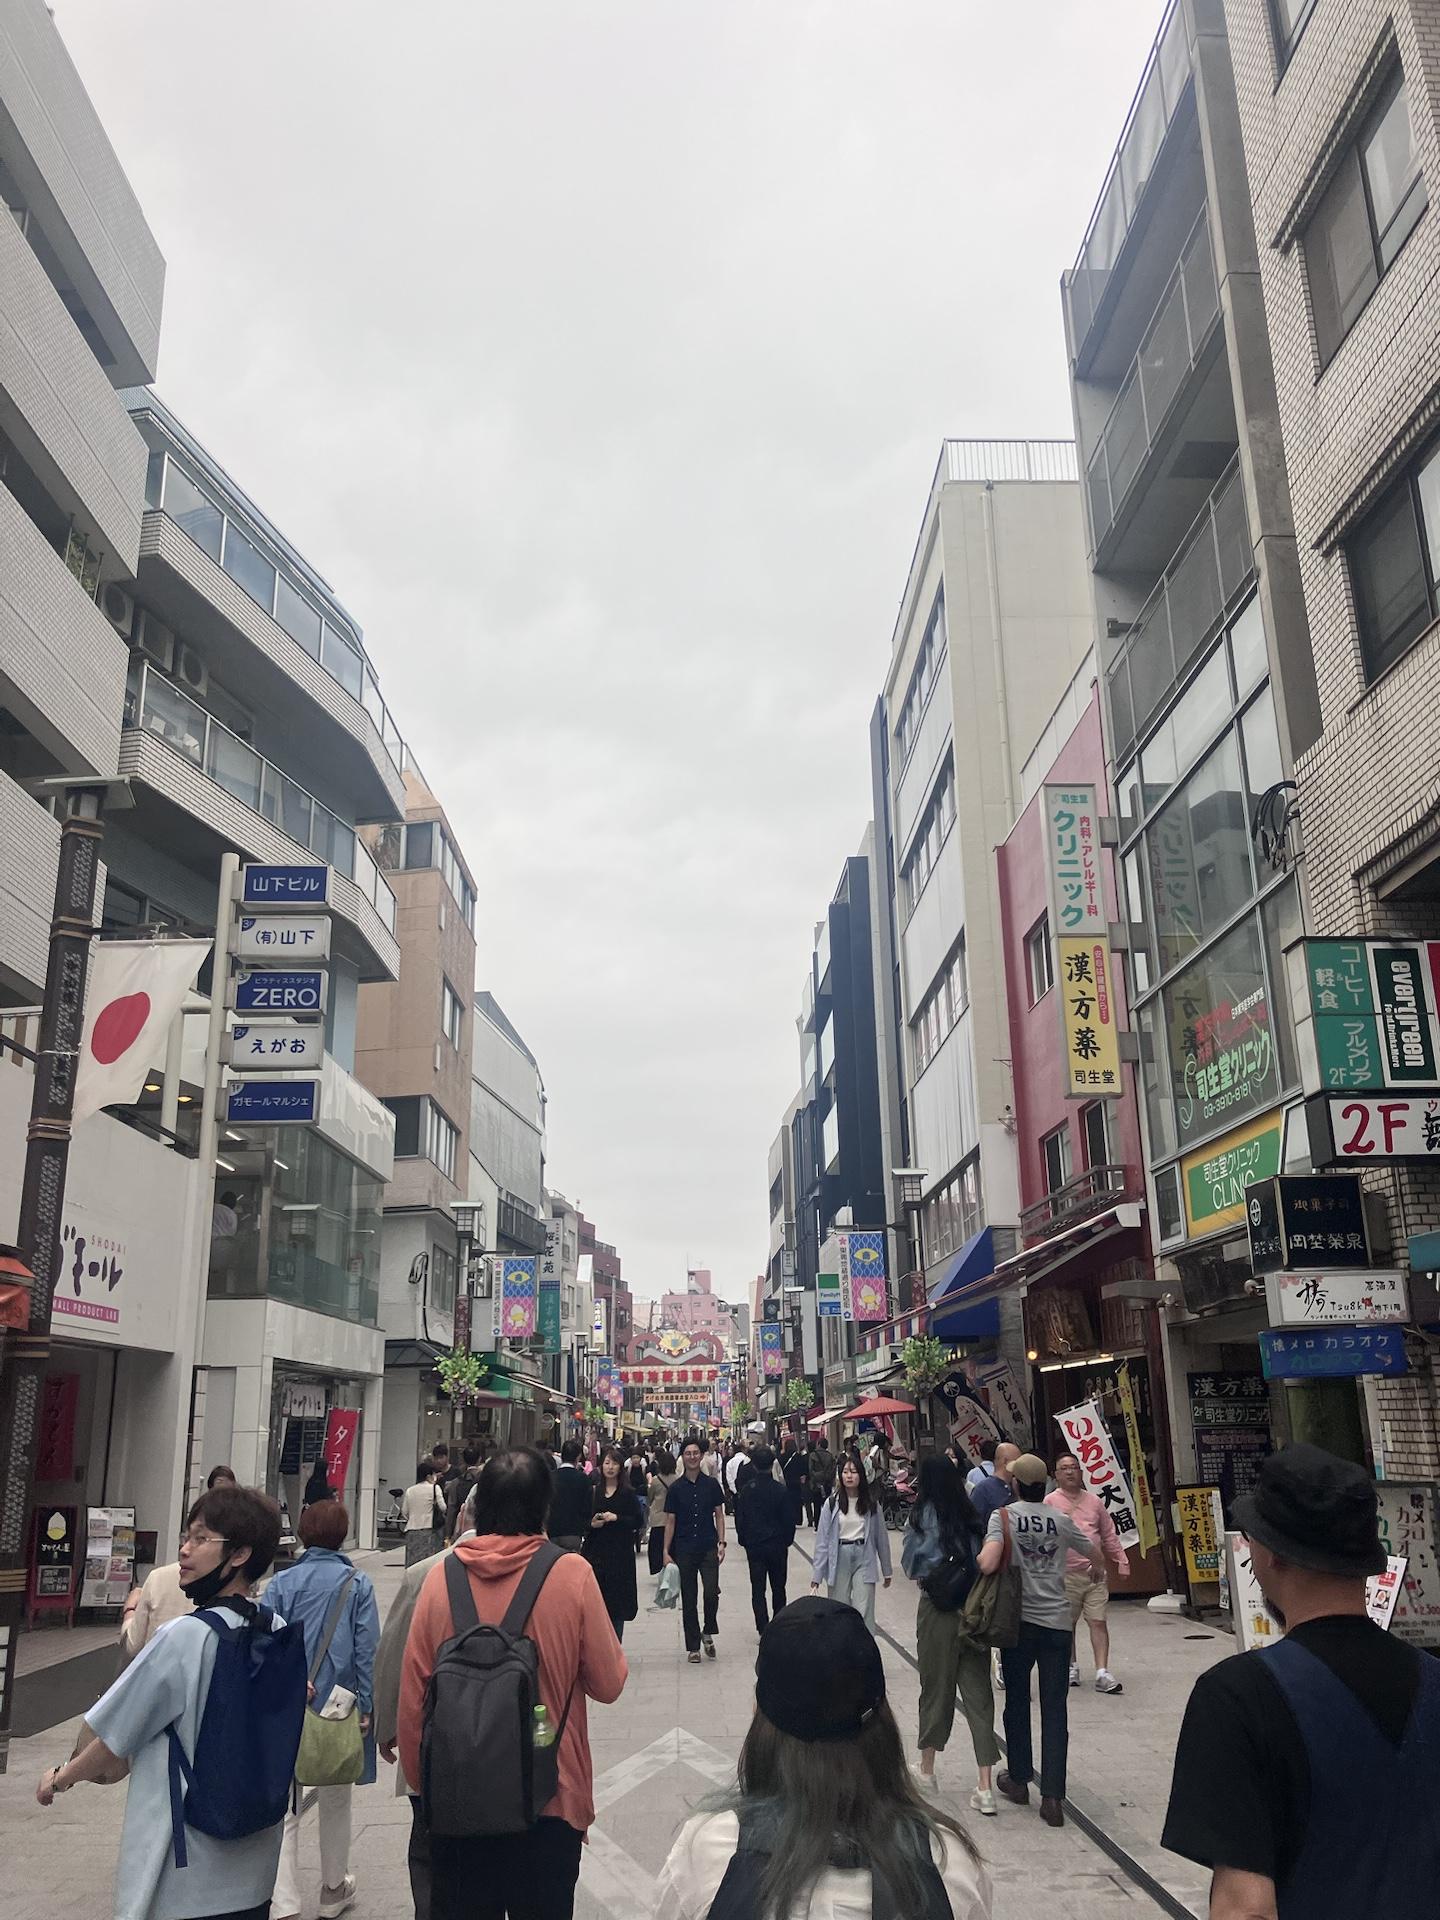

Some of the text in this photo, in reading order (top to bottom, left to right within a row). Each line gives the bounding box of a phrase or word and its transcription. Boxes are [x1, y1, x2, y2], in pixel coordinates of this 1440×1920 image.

[1054, 810, 1083, 927] クリニック
[253, 877, 319, 892] 山下ビル
[1315, 968, 1339, 1009] 軽食
[1340, 946, 1365, 1006] コーヒー
[252, 988, 317, 1006] ZERO
[1065, 952, 1101, 1060] 漢方薬
[1391, 961, 1425, 1067] evergreen
[251, 1039, 306, 1053] えがお
[1074, 1069, 1115, 1084] 司生堂
[1195, 1028, 1270, 1102] 司生堂クリニック
[1329, 1067, 1347, 1085] 2F
[233, 1097, 309, 1107] ガモールマルシェ
[1342, 1103, 1410, 1153] 2F
[1202, 1140, 1260, 1184] 司生堂クリニック
[74, 1303, 103, 1318] PRODUCT
[1324, 1334, 1389, 1349] カラオケ
[1194, 1377, 1264, 1397] 漢方薬
[1205, 1407, 1271, 1423] 司生堂クリニック
[1064, 1417, 1136, 1536] いちご大福
[1017, 1515, 1059, 1536] USA
[1183, 1493, 1205, 1553] 漢方薬
[1397, 1506, 1410, 1556] カラオ
